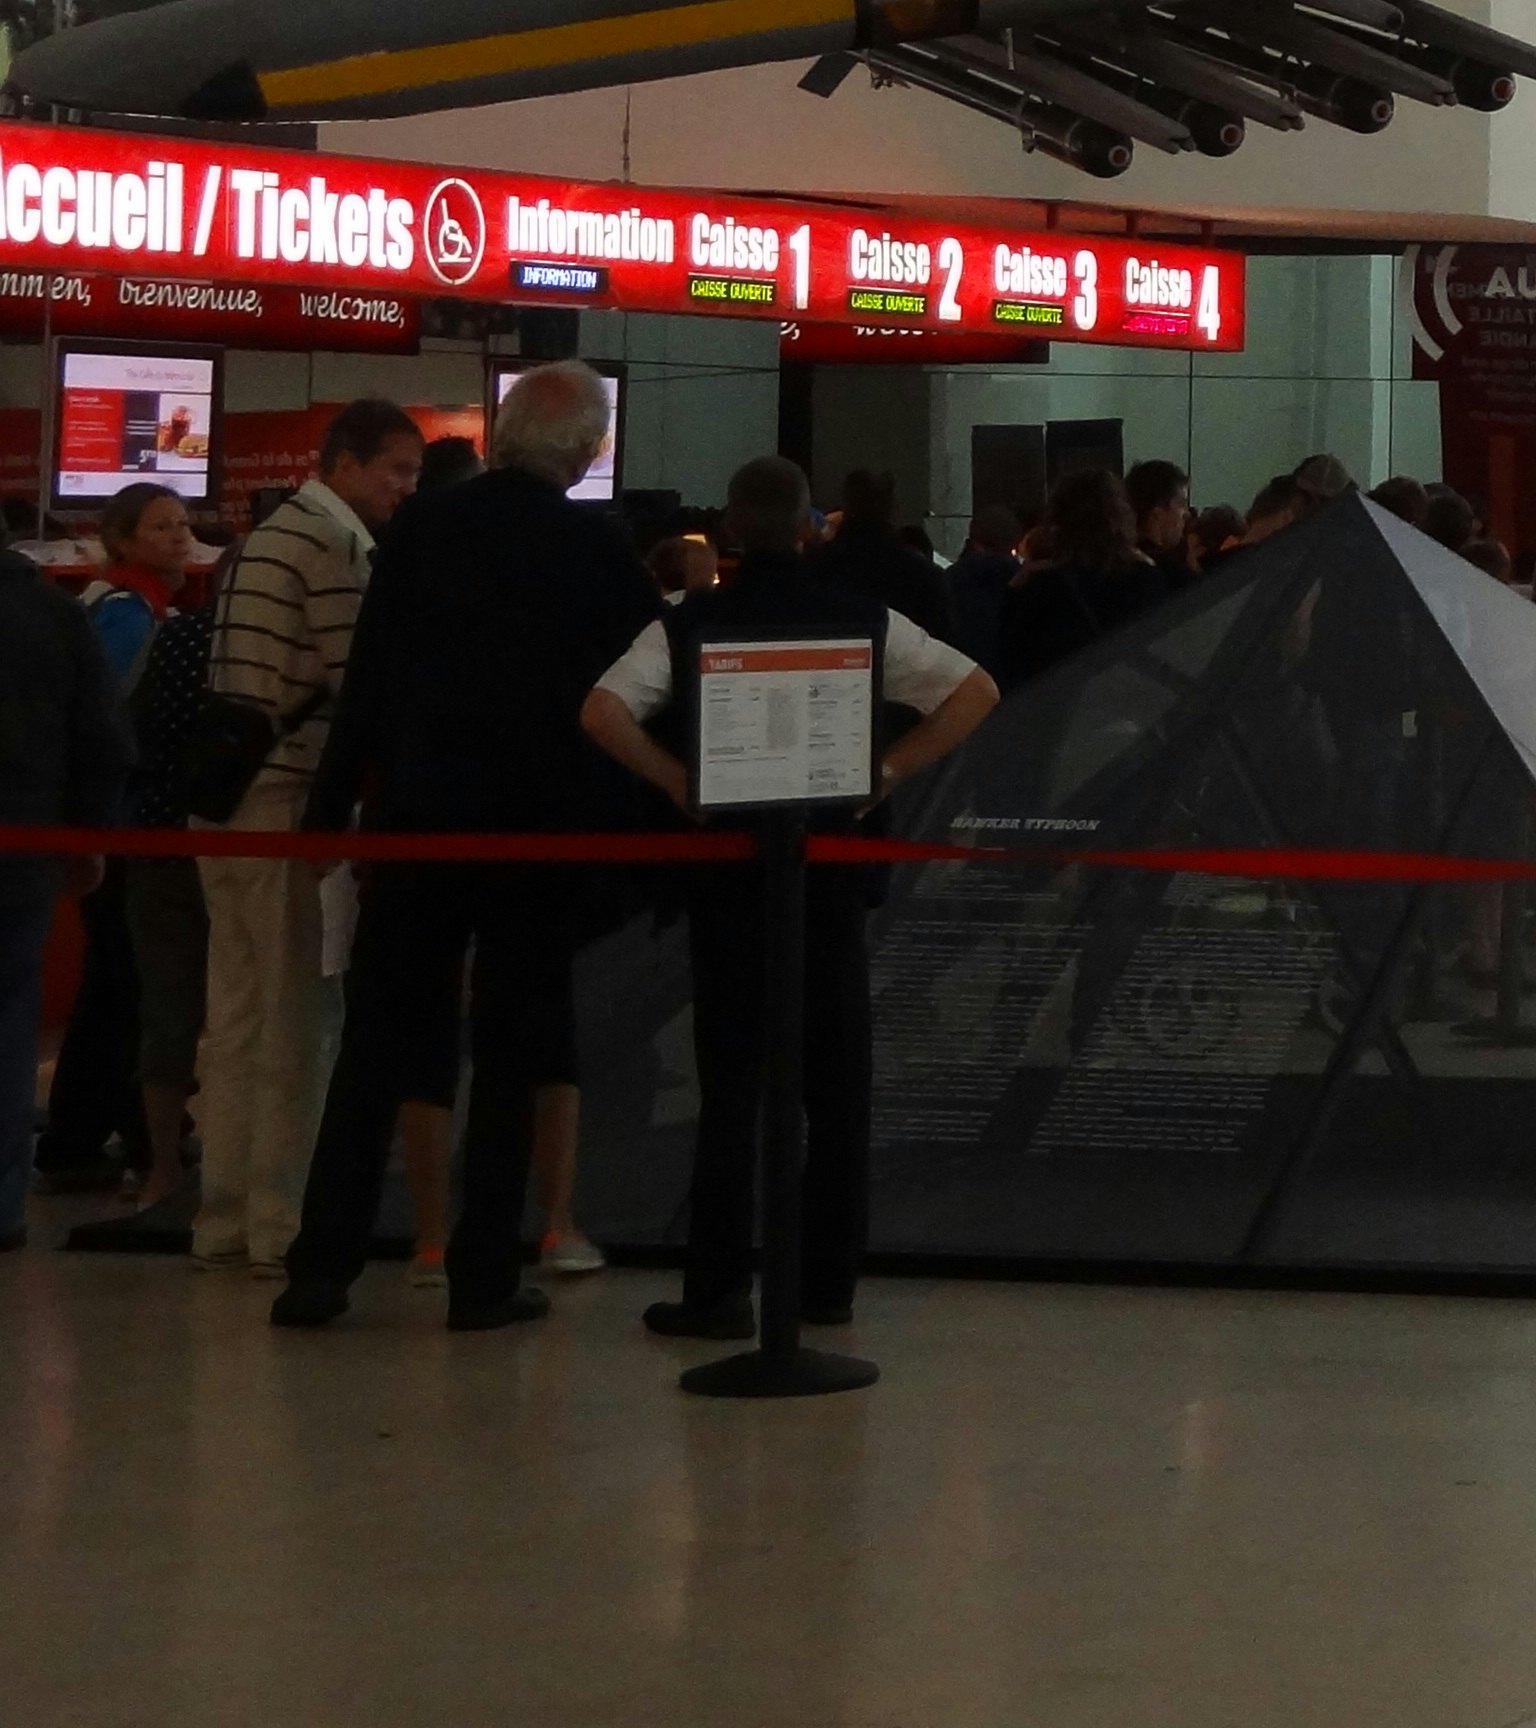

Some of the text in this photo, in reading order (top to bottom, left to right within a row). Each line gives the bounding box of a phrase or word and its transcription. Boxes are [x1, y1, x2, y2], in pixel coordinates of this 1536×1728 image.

[231, 168, 414, 270] Tickets
[508, 196, 674, 263] Information
[523, 265, 597, 289] INFORMATION
[691, 213, 811, 310] Caisse 1
[851, 228, 964, 321] Caisse 2
[994, 243, 1098, 330] Caisse 3
[301, 293, 405, 329] welcome,
[691, 279, 773, 301] CAISSE OUVERTE
[851, 292, 925, 313] CAISSE OUVERTE
[995, 304, 1063, 324] CAISSE OUVERTE
[1126, 256, 1221, 341] Caisse 4
[1024, 818, 1101, 831] TYPHOON
